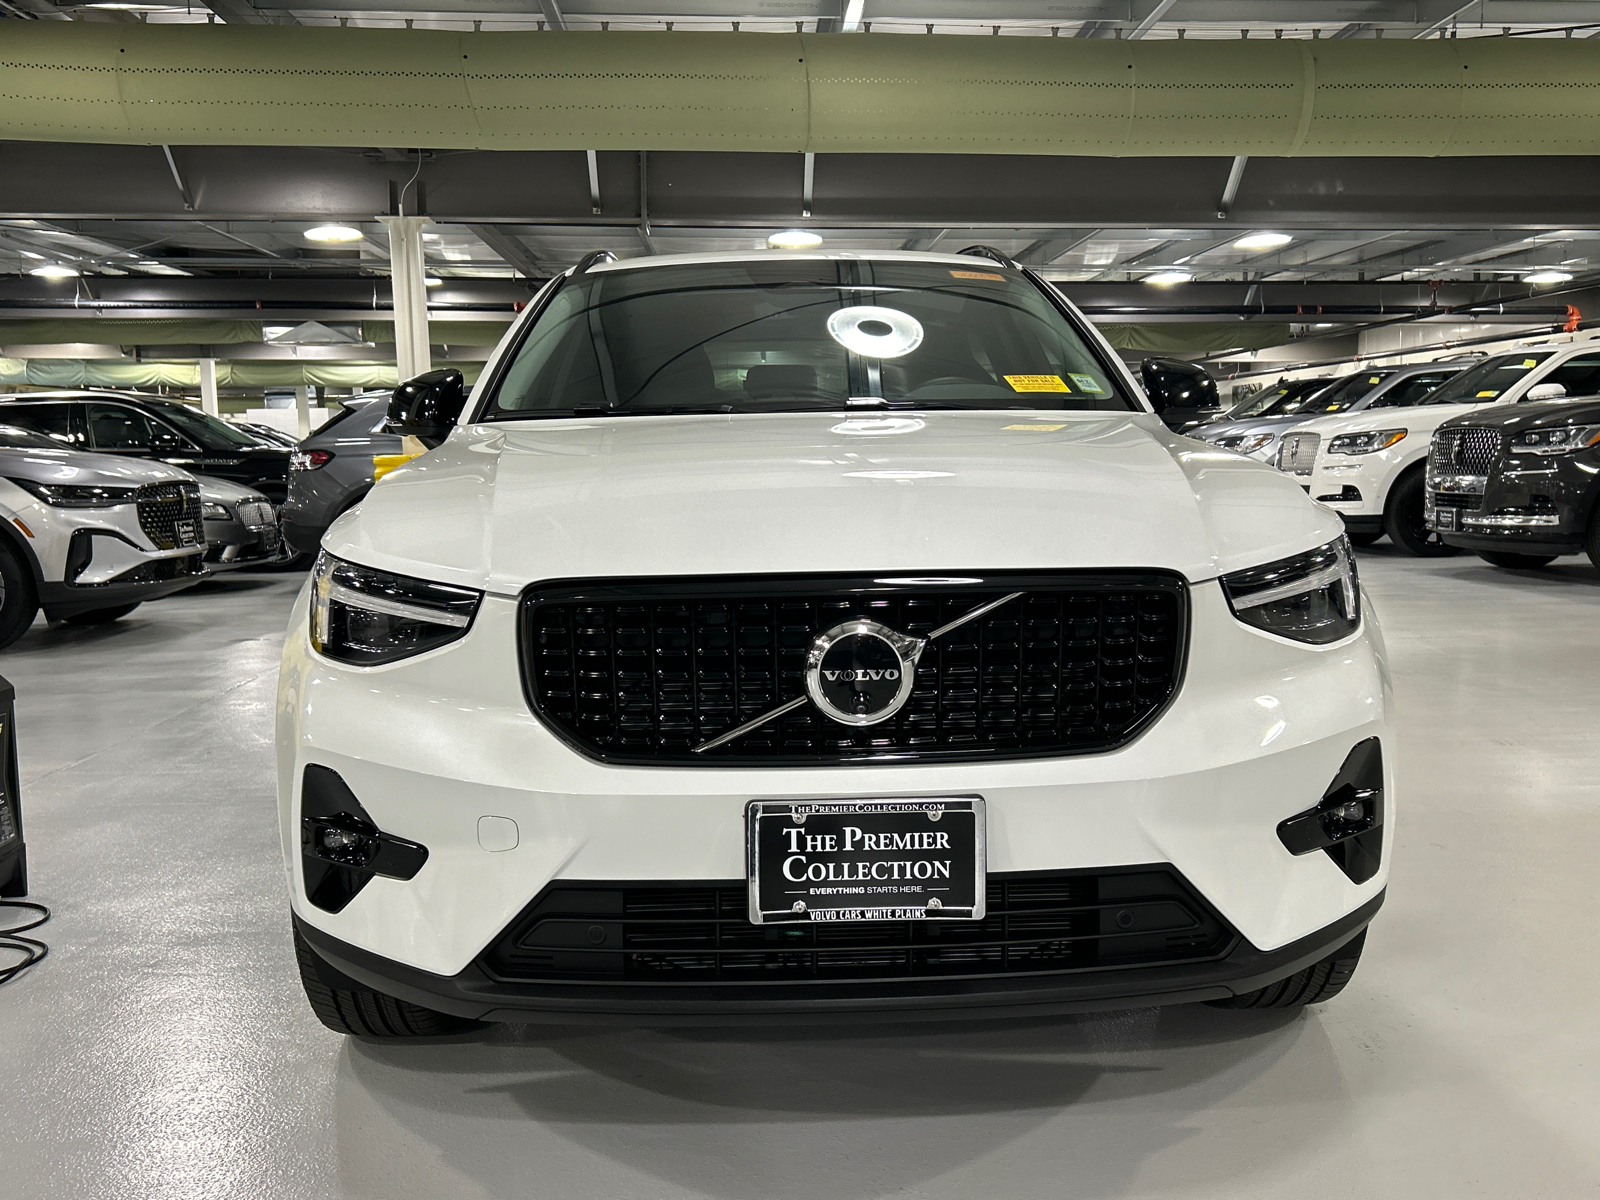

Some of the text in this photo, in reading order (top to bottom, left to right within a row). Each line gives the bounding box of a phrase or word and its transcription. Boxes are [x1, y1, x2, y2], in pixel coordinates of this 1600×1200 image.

[821, 669, 900, 681] VOLVO
[782, 826, 952, 852] THE PREMIER
[782, 855, 952, 882] COLLECTION
[809, 886, 865, 895] EVERYTHING
[899, 885, 925, 893] HERE.
[810, 909, 927, 920] VOLVO CARS WHITE PLAINS
